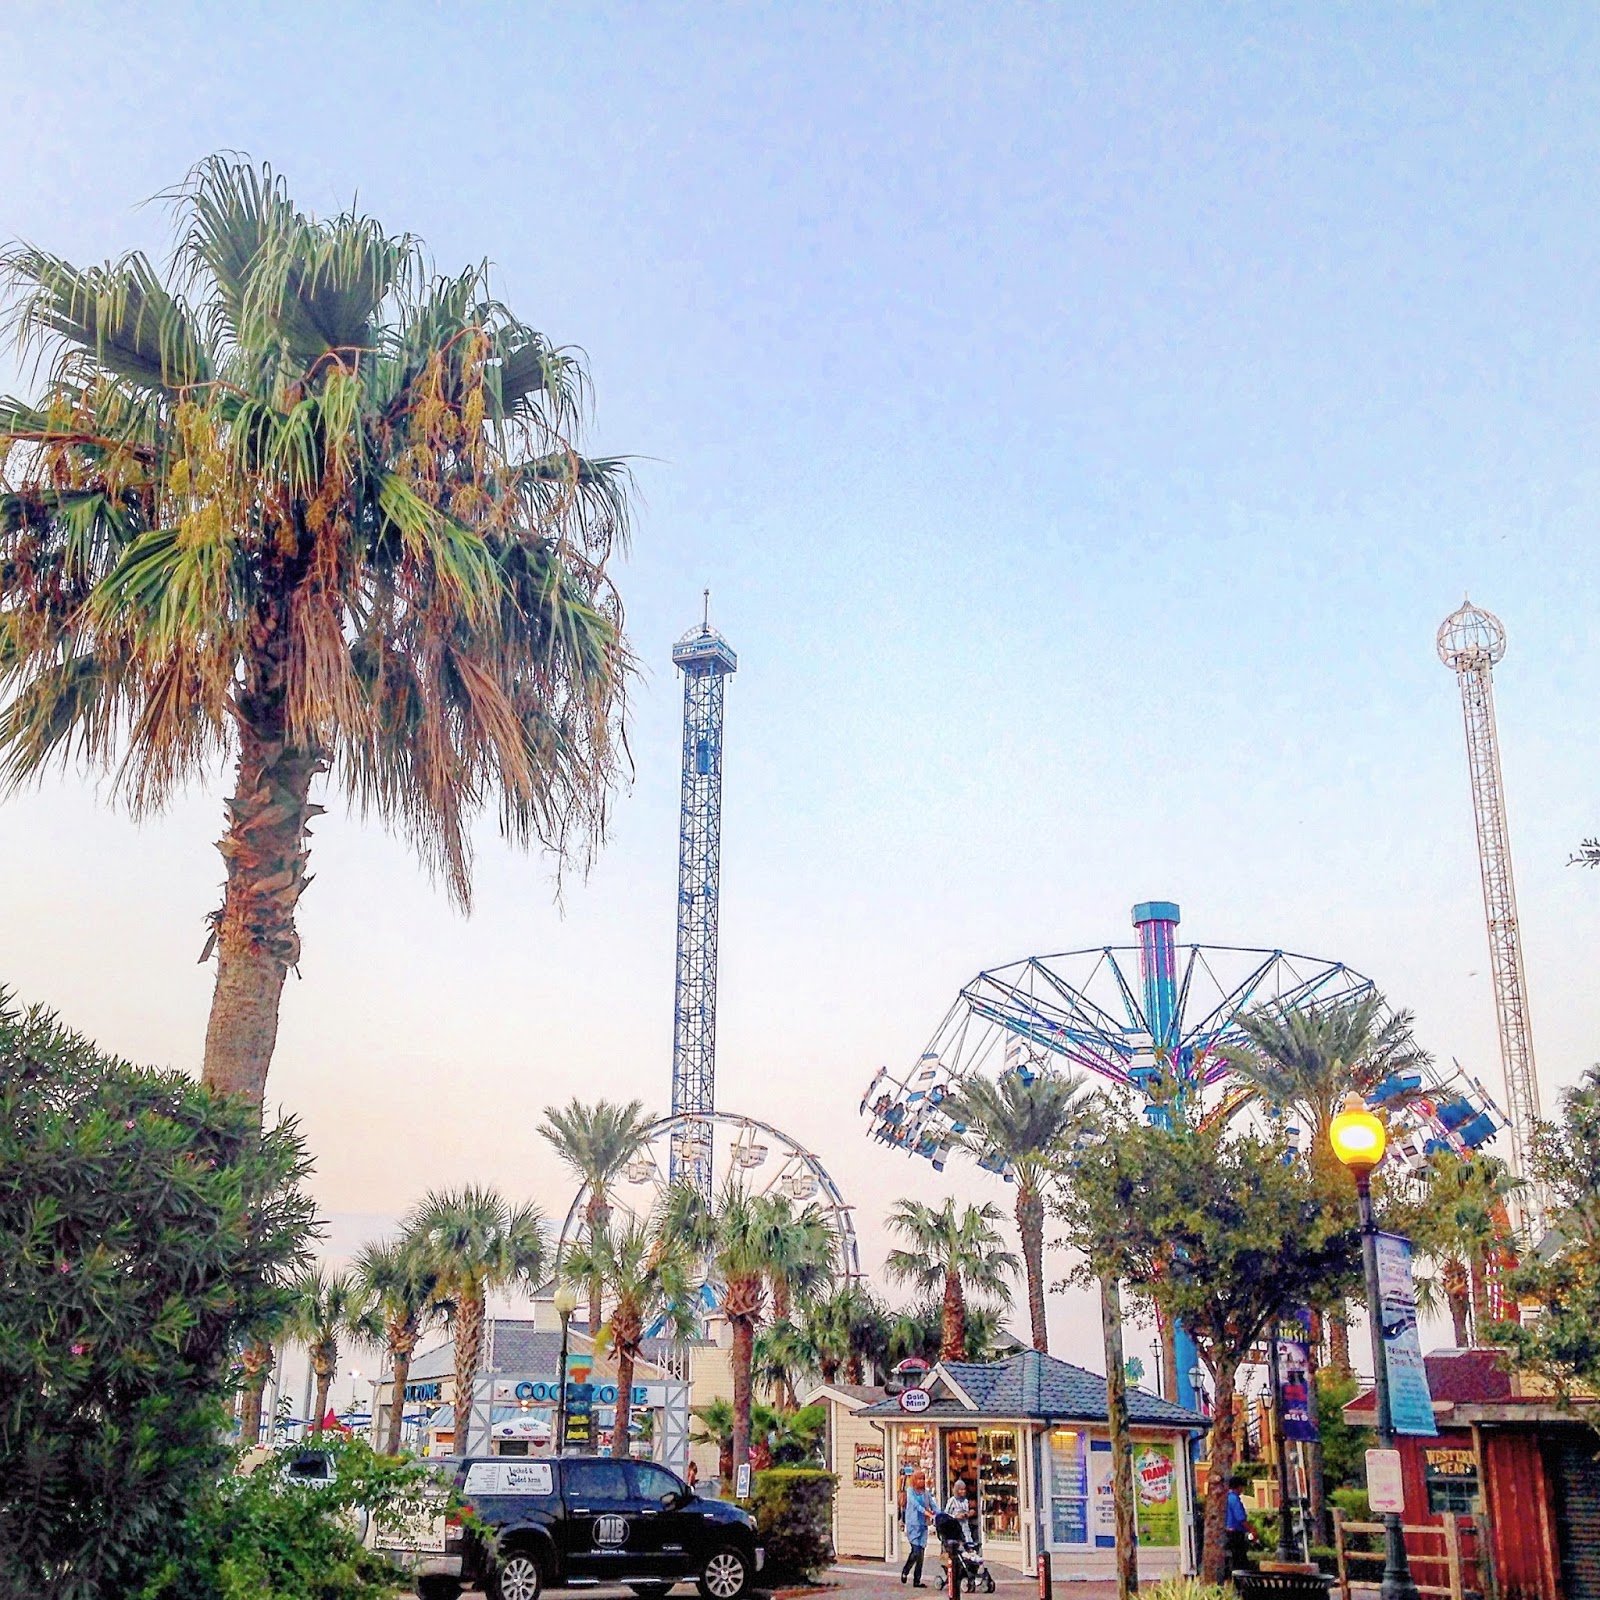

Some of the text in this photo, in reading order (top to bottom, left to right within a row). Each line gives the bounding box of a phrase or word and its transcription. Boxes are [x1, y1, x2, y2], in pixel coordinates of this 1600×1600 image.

[592, 1385, 649, 1404] ZOE
[1425, 1449, 1480, 1466] WESTERN
[1440, 1463, 1466, 1474] WEAR
[599, 1519, 625, 1539] MIB
